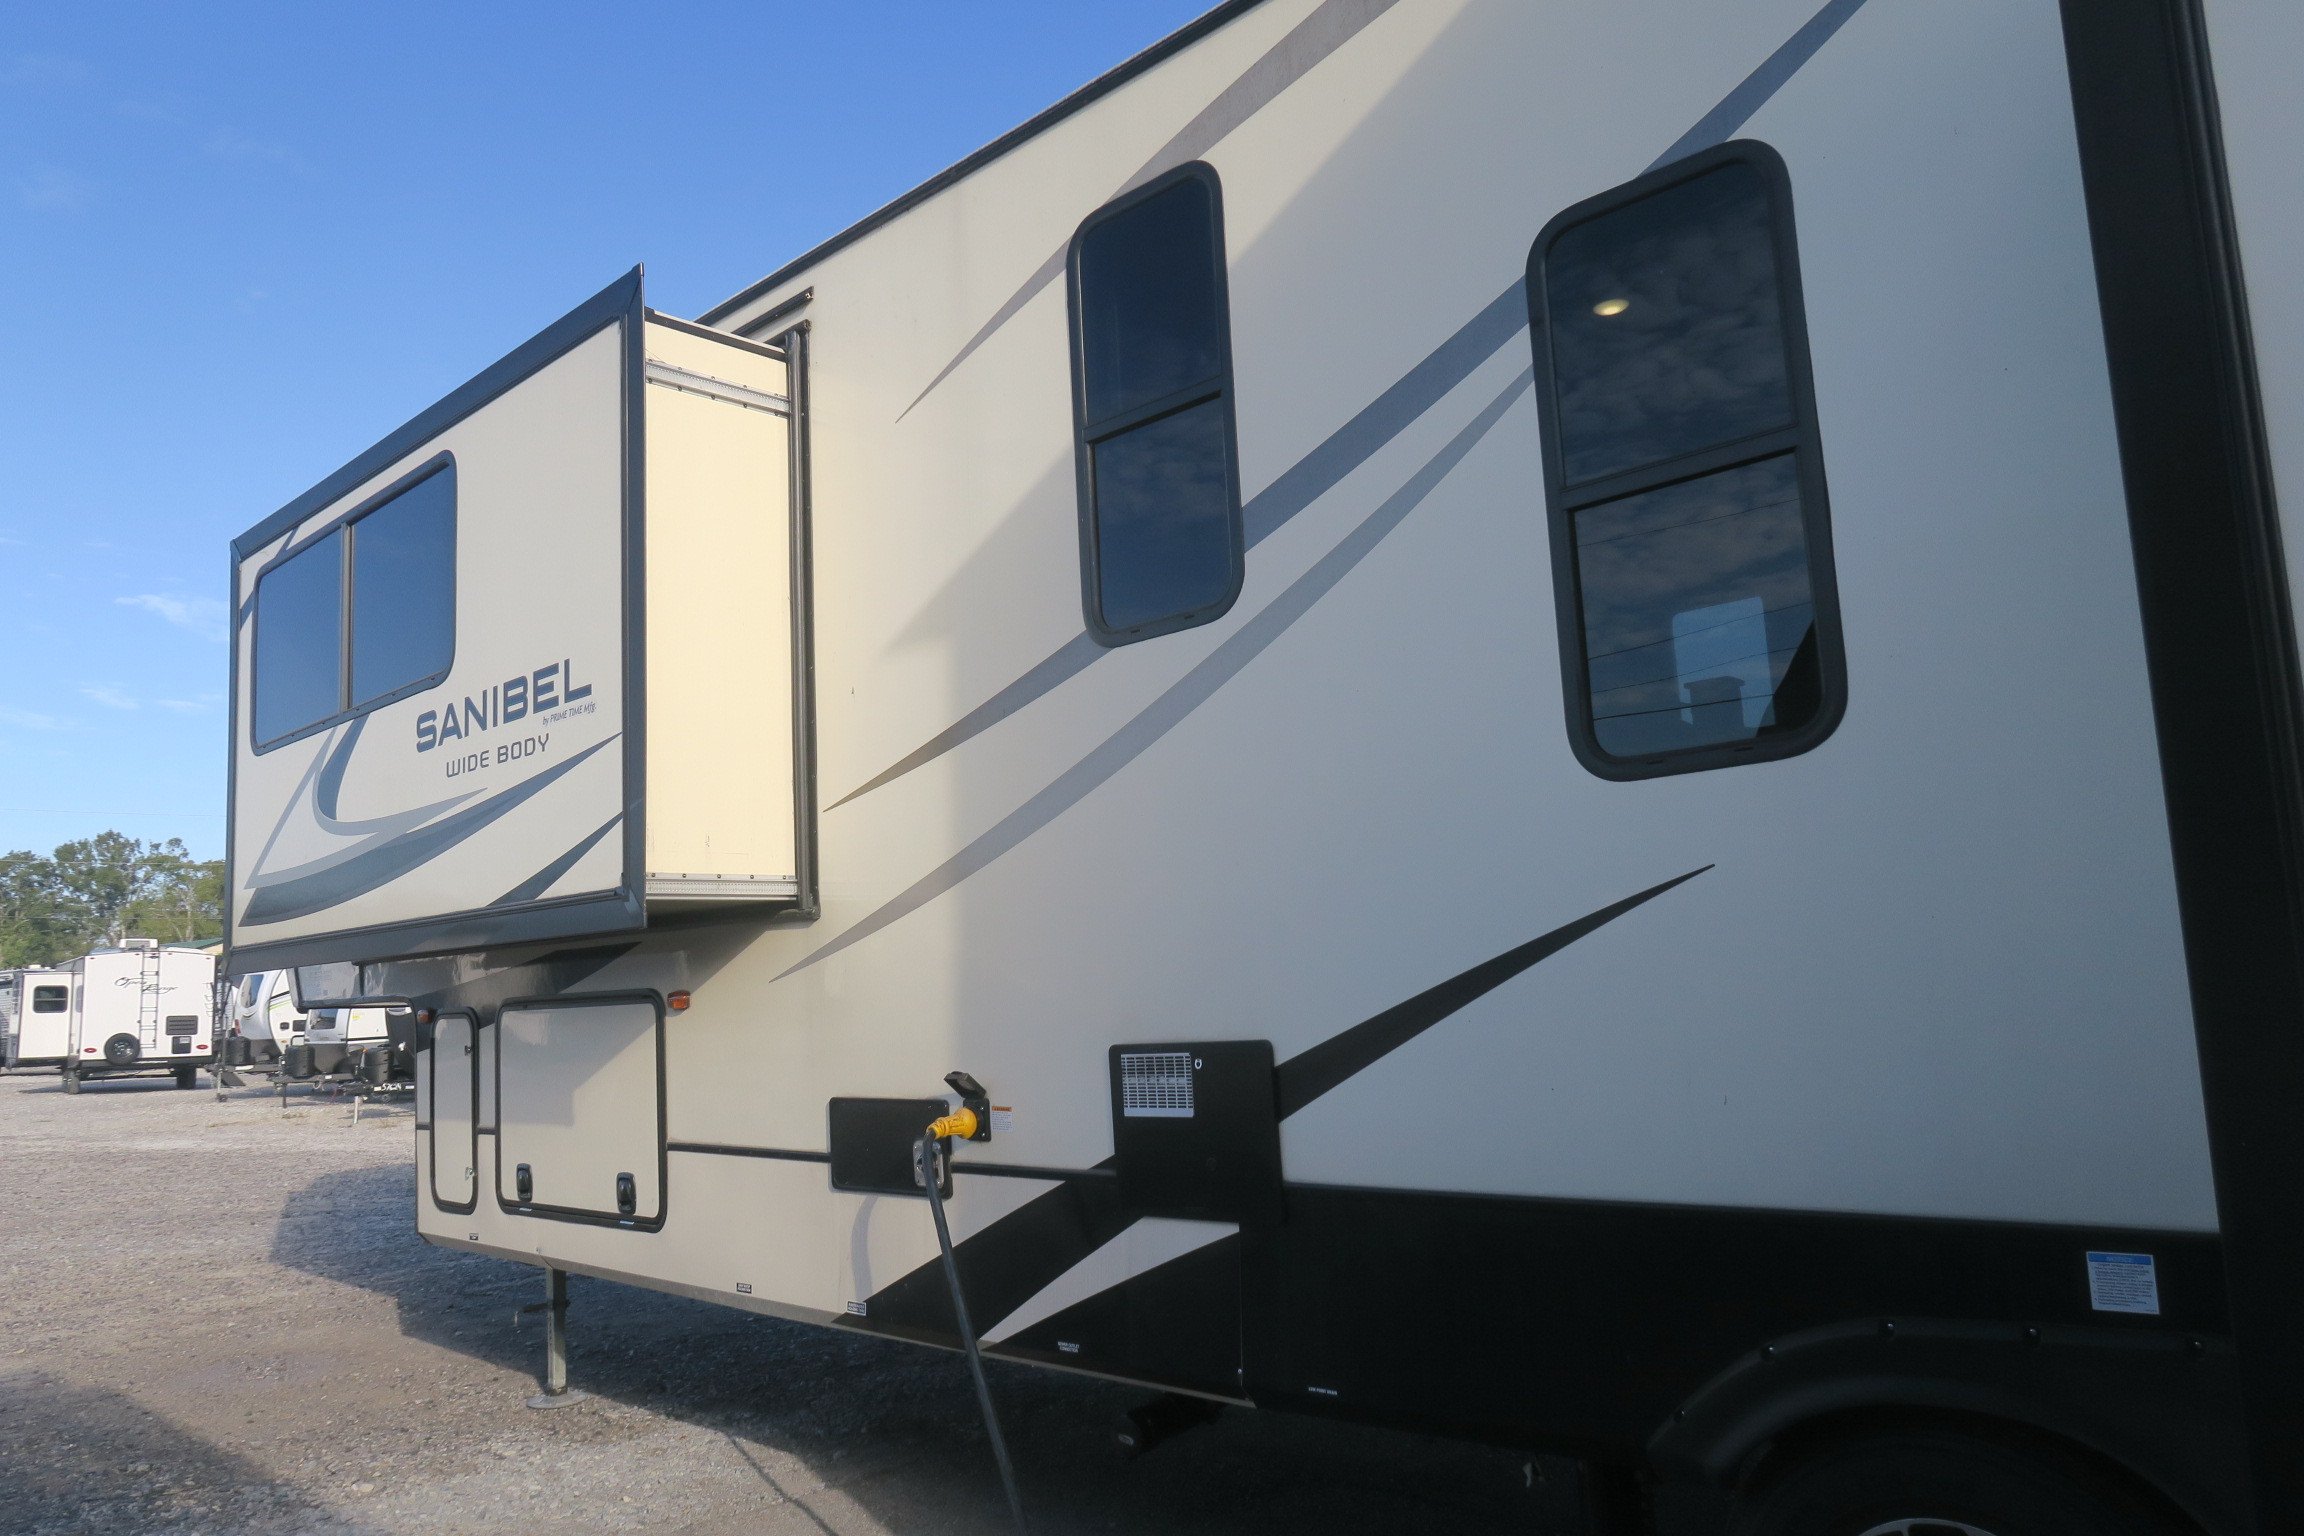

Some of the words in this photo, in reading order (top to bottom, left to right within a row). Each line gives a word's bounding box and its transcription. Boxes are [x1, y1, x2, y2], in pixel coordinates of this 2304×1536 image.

[416, 658, 592, 753] SANIBEL
[542, 716, 550, 726] by
[550, 709, 567, 723] PRIME
[569, 704, 582, 717] TIME
[446, 750, 490, 778] WIDE
[497, 733, 549, 764] BODY
